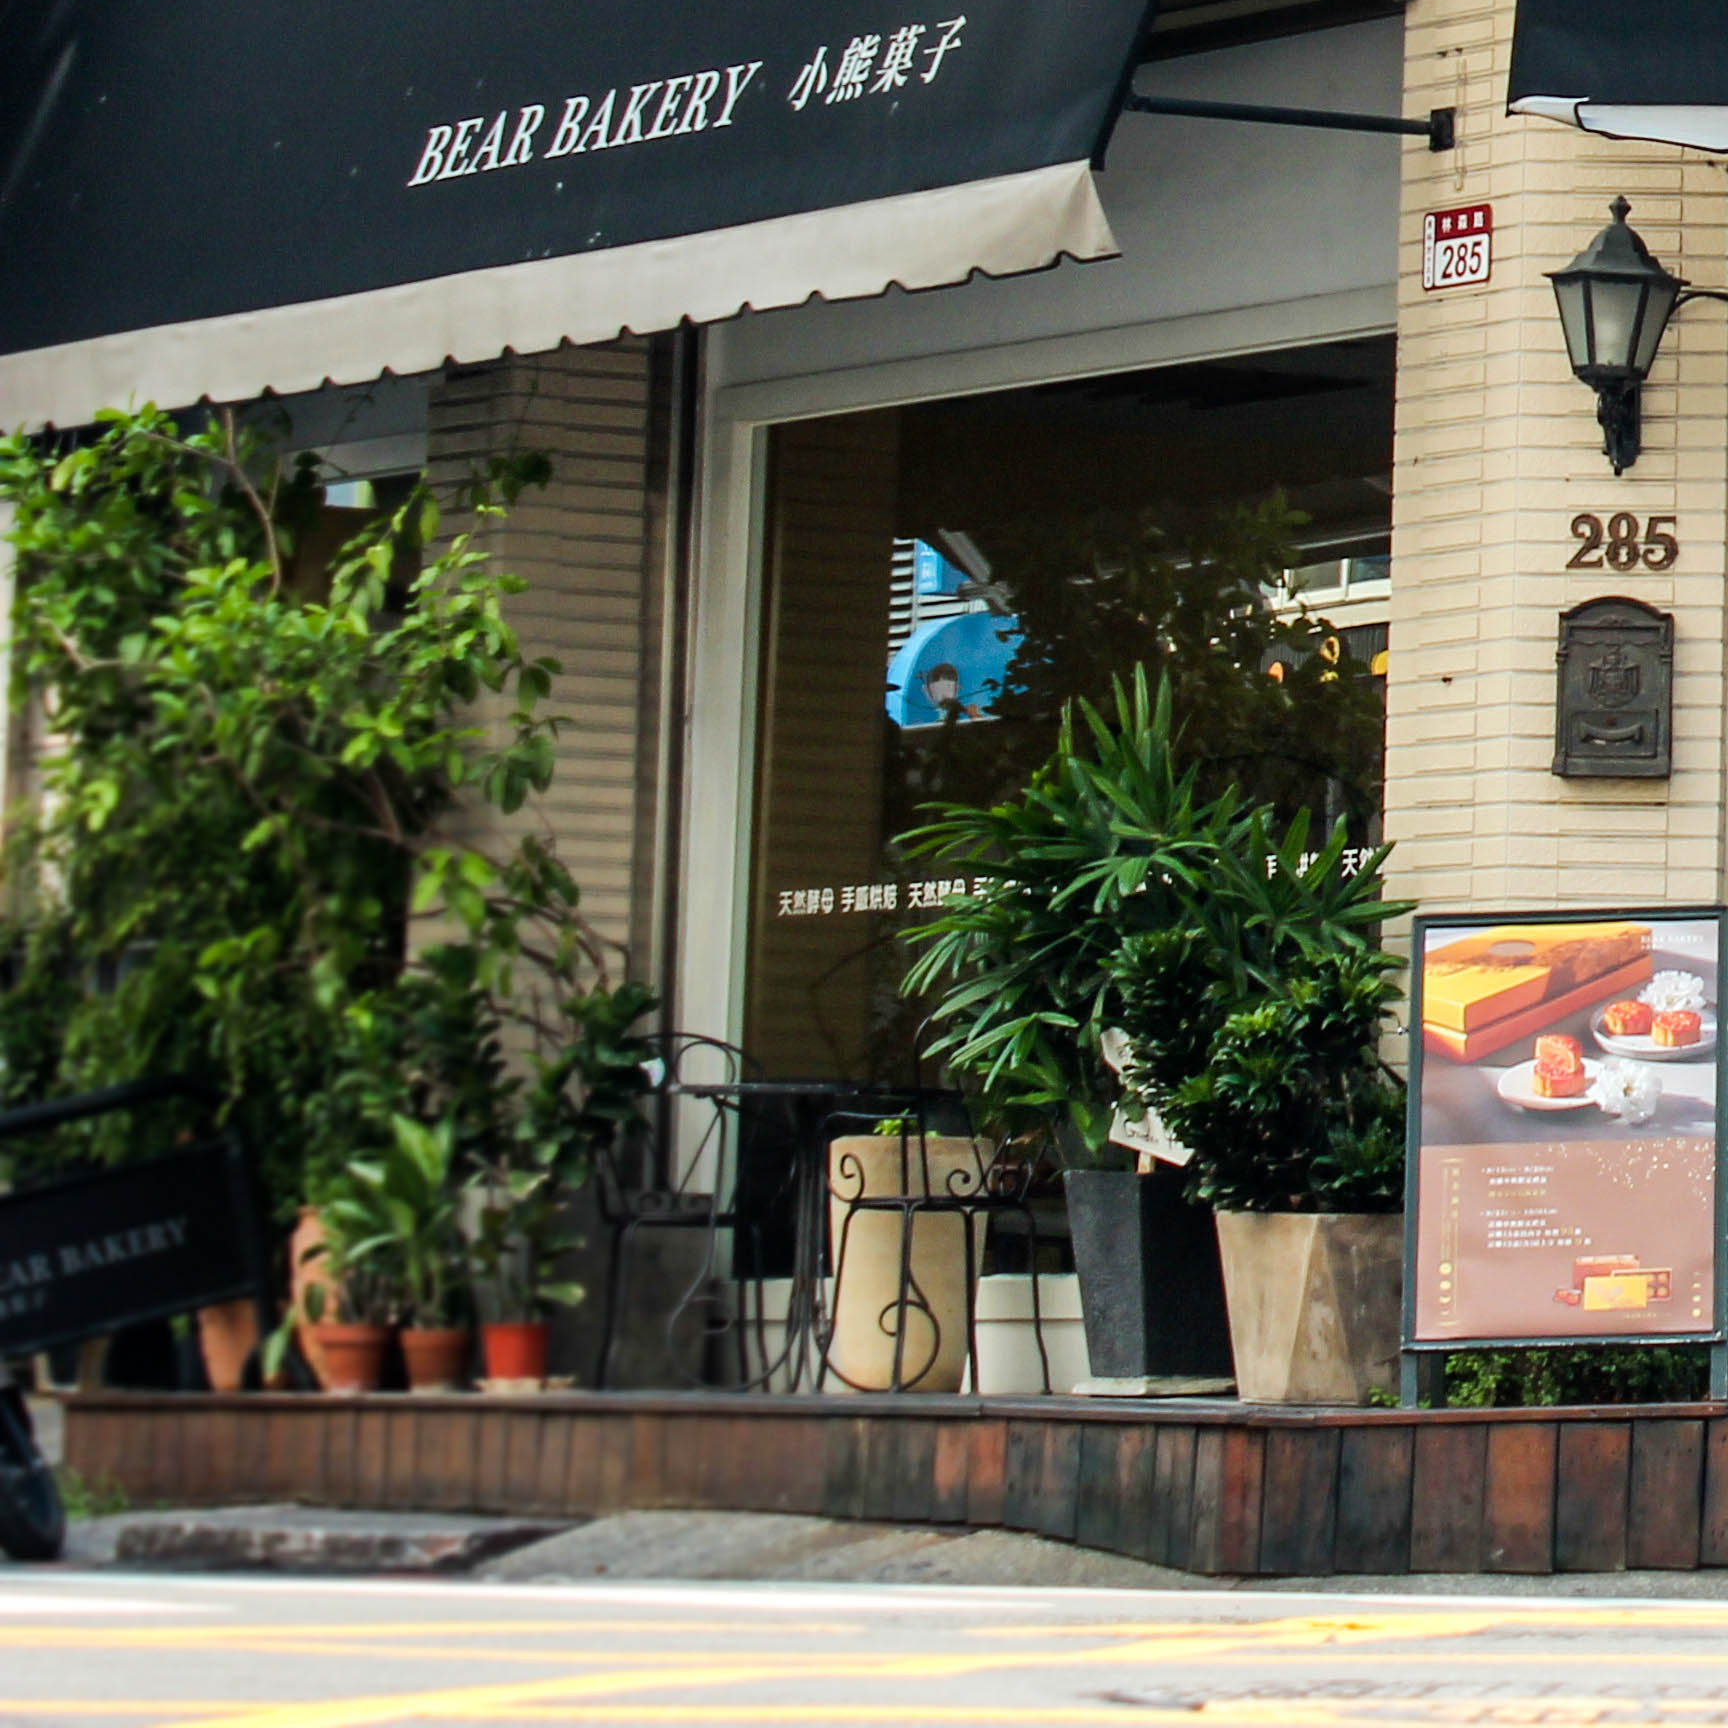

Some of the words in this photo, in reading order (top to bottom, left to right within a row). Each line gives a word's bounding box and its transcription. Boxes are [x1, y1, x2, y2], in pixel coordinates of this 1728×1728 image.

[406, 102, 546, 189] BEAR
[543, 60, 764, 160] BAKERY
[786, 14, 968, 112] 小熊菓子
[1441, 240, 1483, 279] 285
[1566, 512, 1680, 571] 285
[778, 886, 835, 917] 天然酵母
[840, 882, 899, 914] 手感烘焙
[59, 1217, 188, 1276] BAKERY
